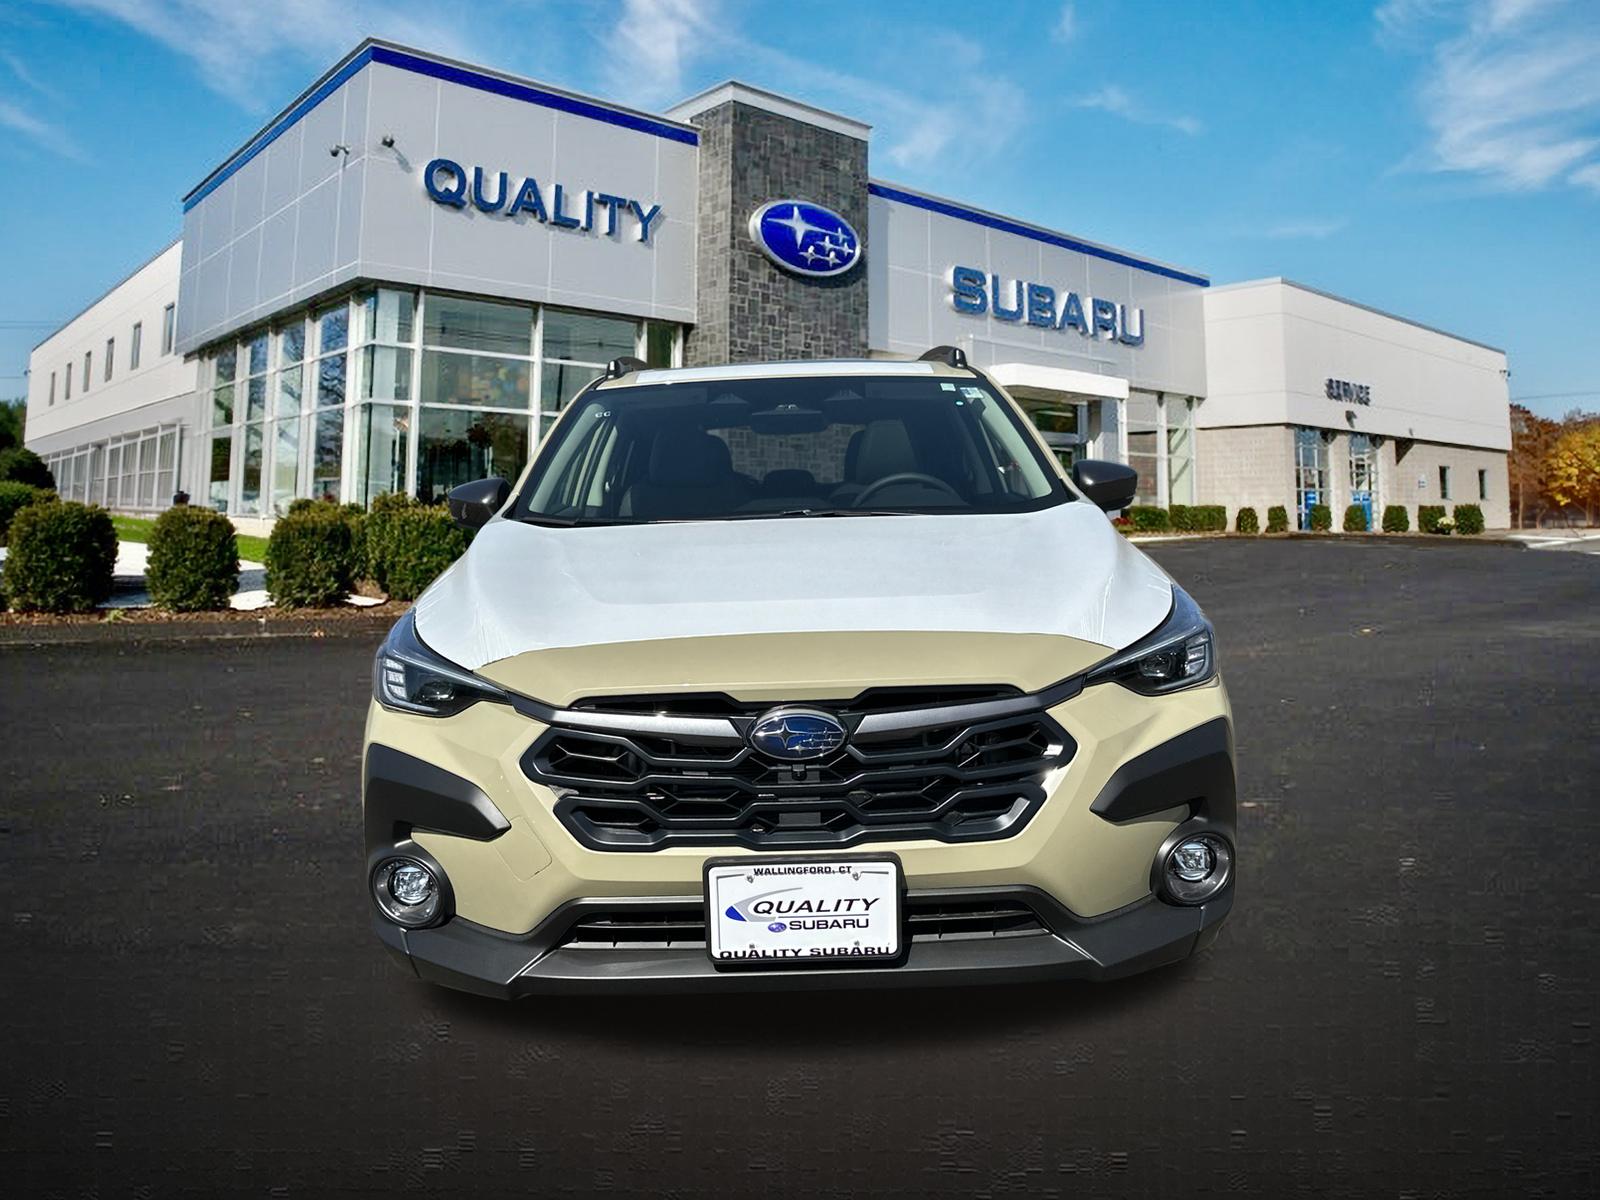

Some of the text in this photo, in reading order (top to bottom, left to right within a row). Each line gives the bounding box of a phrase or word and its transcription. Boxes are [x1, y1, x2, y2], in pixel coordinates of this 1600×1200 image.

[424, 158, 662, 242] QUALITY
[951, 265, 1145, 346] SUBARU
[838, 866, 852, 874] CT
[753, 898, 880, 914] QUALITY
[789, 919, 870, 930] SUBARU
[719, 946, 889, 959] QUALITY SUBARU
